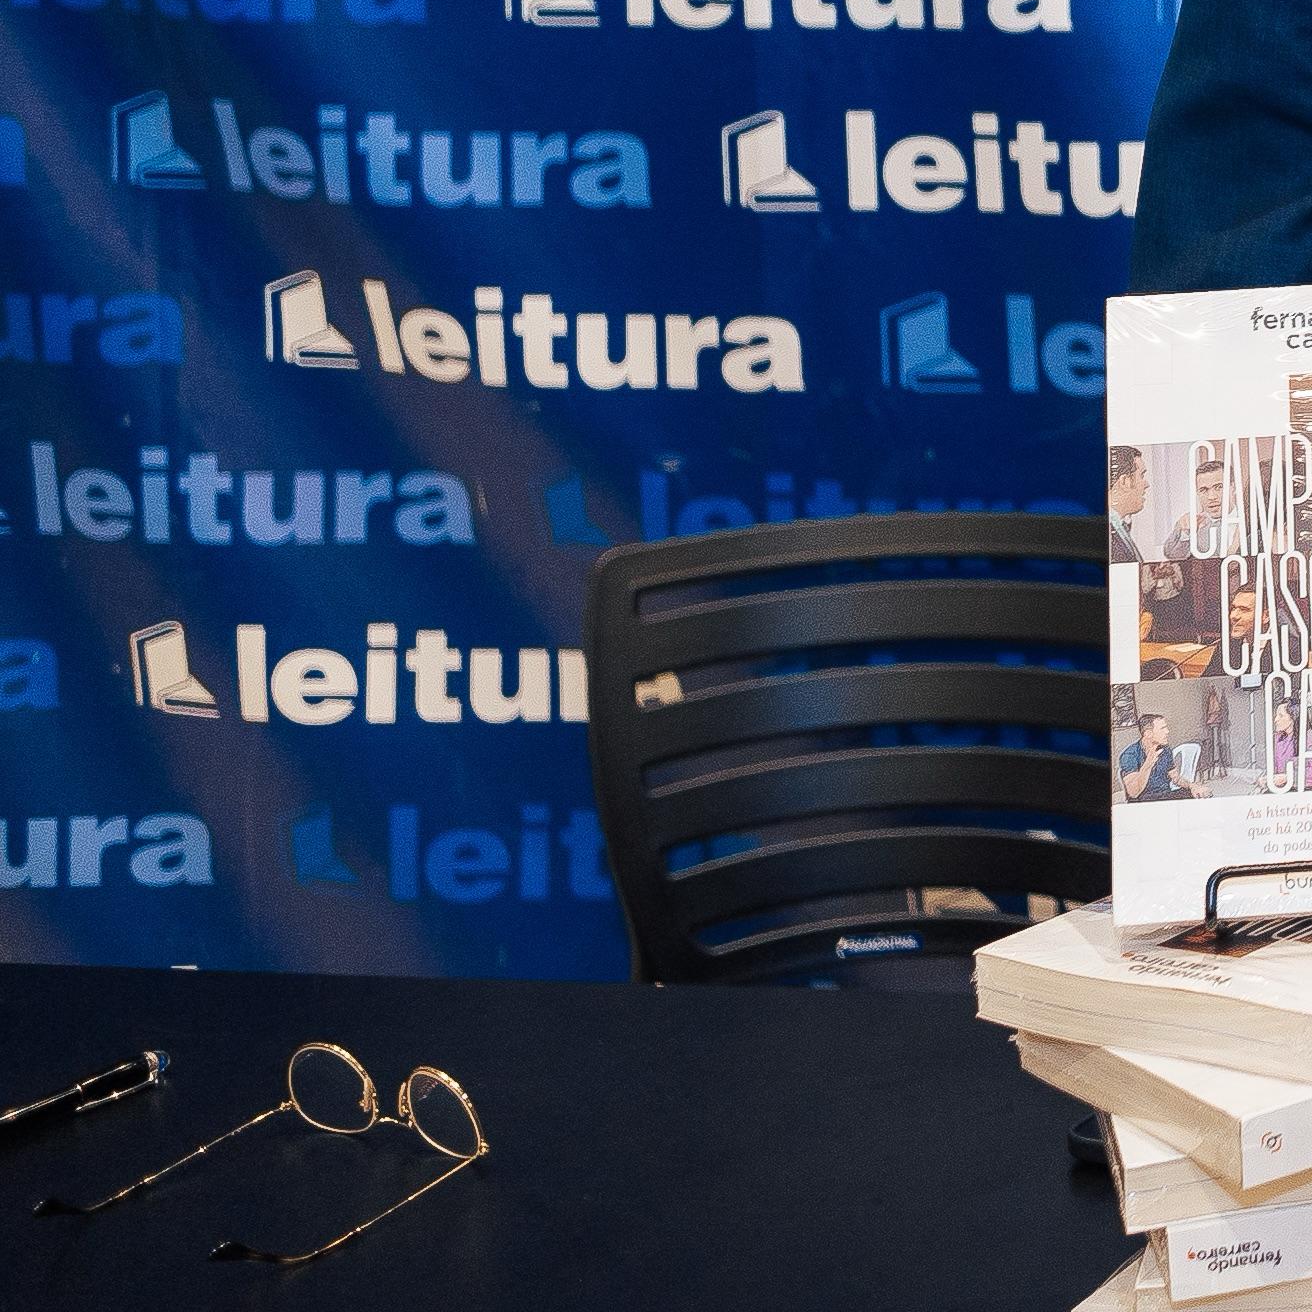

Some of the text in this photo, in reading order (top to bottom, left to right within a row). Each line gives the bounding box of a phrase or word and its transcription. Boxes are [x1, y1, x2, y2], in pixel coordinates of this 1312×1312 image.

[213, 97, 652, 208] leitura
[845, 110, 1147, 218] leitu
[363, 278, 805, 393] leitura
[30, 441, 477, 545] leitura
[389, 806, 612, 902] leit
[1246, 807, 1262, 820] As
[1247, 826, 1272, 840] que
[1296, 821, 1312, 834] 20
[1263, 840, 1279, 854] do
[1207, 1248, 1284, 1274] fernando
